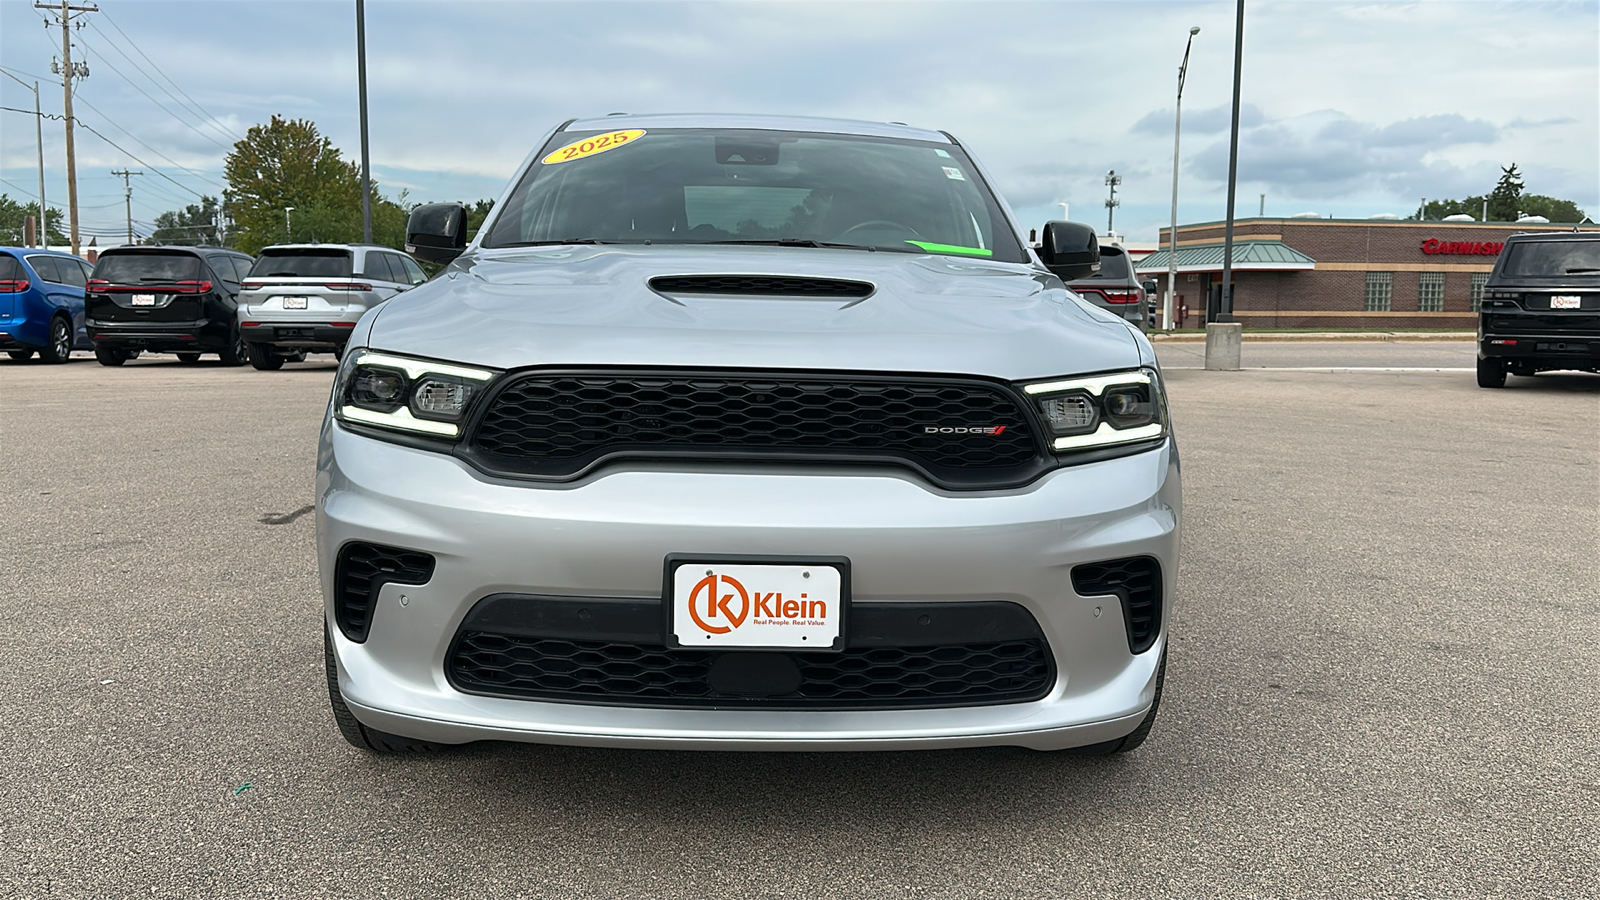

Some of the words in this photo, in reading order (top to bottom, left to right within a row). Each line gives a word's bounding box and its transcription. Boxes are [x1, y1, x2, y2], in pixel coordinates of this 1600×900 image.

[563, 132, 628, 160] 2025
[1422, 238, 1505, 255] CARWASH
[754, 592, 827, 618] Klein
